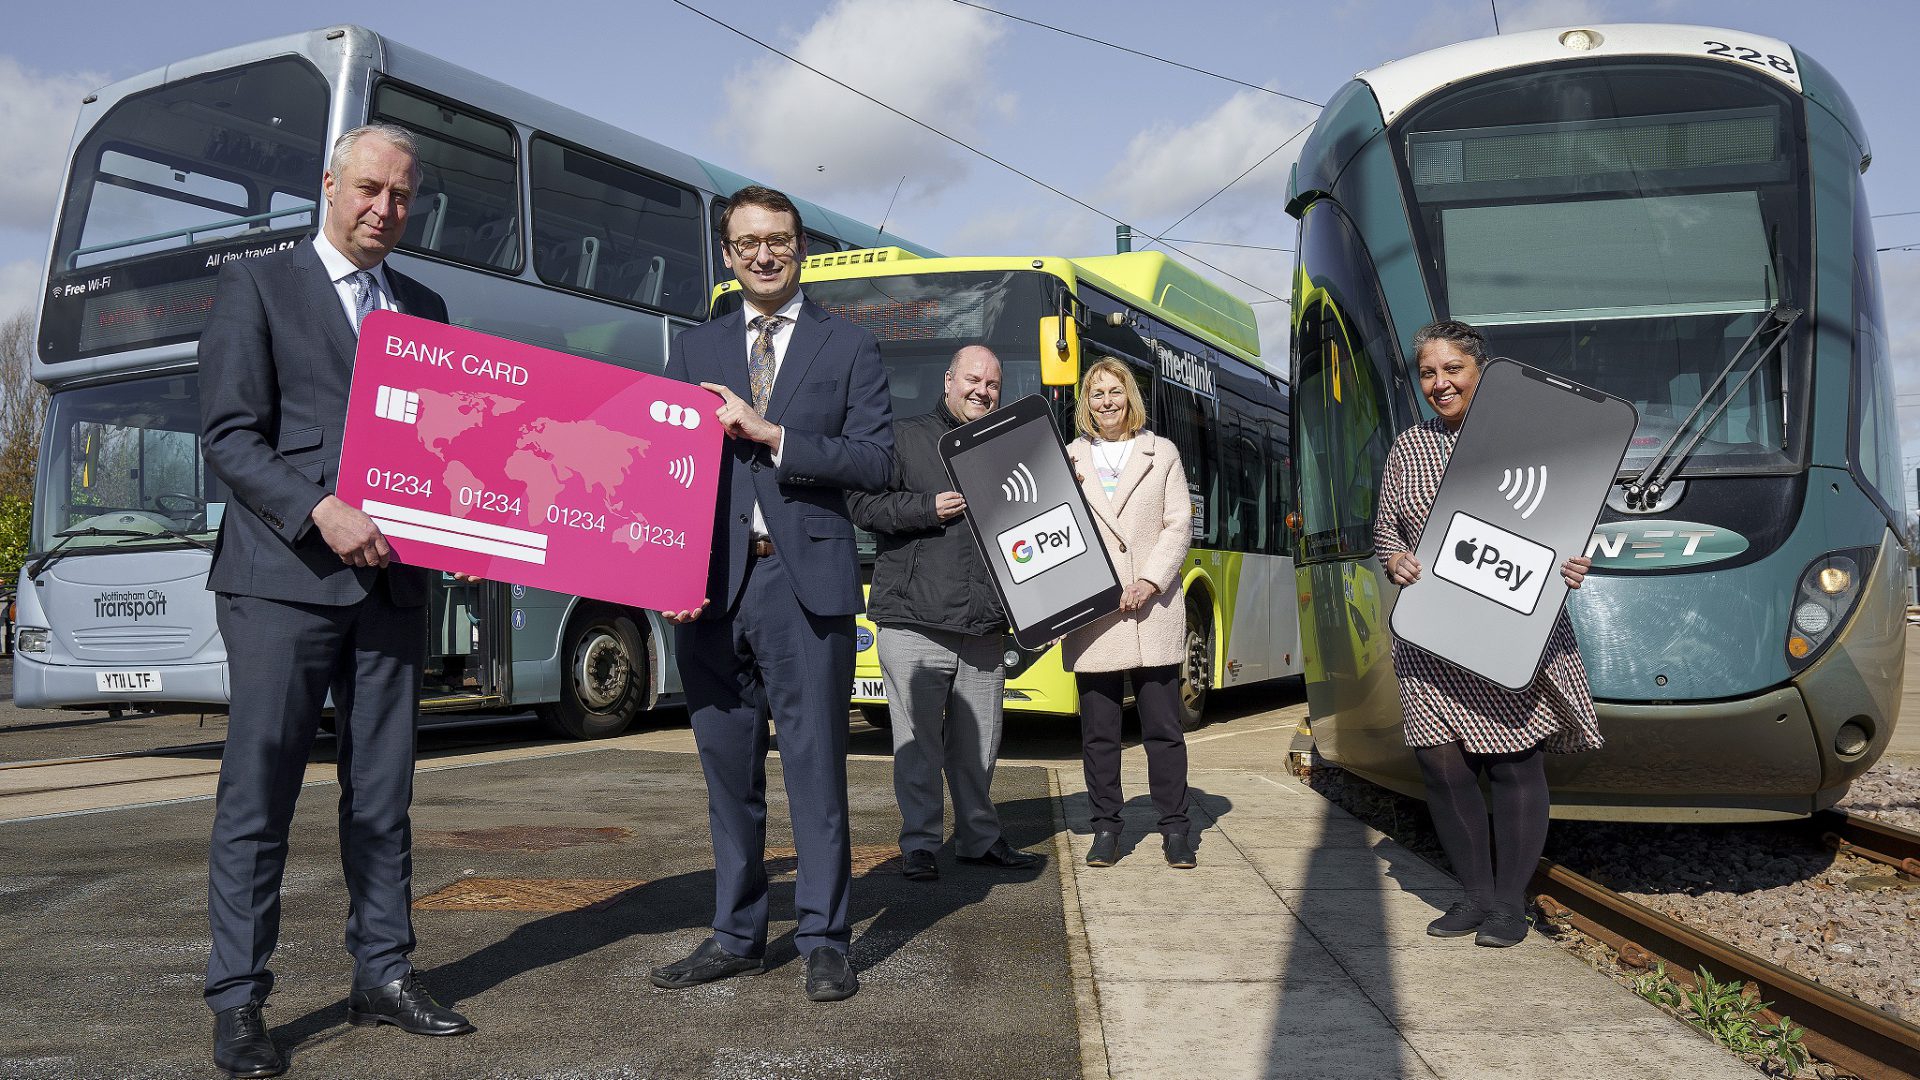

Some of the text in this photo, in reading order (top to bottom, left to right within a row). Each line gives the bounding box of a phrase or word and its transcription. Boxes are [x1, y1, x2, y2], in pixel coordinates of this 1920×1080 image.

[1703, 41, 1795, 74] 228
[205, 253, 221, 268] All
[222, 251, 243, 264] day
[245, 243, 277, 258] travel
[64, 276, 112, 297] Free Wi-Fi
[385, 335, 529, 386] BANK CARD
[1160, 349, 1215, 397] medilink
[366, 467, 687, 549] 01234 01234 01234 01234
[1012, 525, 1071, 564] G Pay
[1585, 529, 1717, 560] NET
[1475, 543, 1534, 592] Pay
[93, 595, 168, 622] Transport
[101, 589, 164, 605] Nottingham City
[127, 672, 151, 689] LTF
[862, 681, 888, 697] NM
